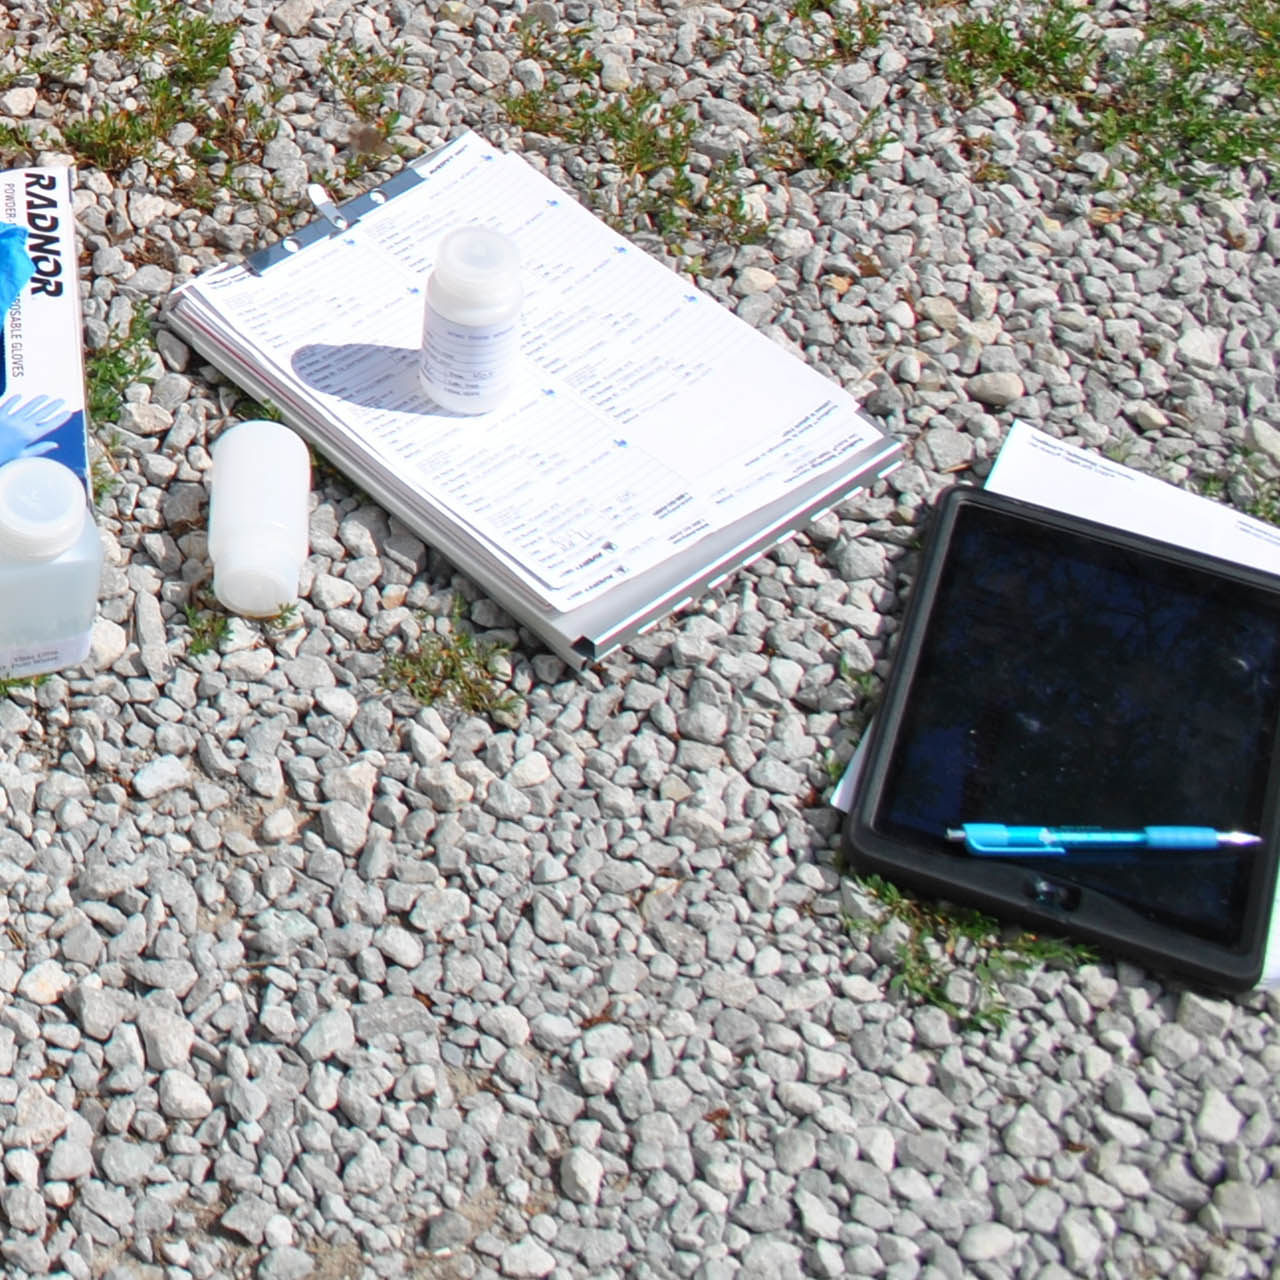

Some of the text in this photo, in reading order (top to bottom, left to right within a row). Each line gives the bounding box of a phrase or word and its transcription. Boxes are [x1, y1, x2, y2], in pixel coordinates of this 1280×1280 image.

[3, 183, 24, 378] POWDER- POSABLE GLOVES
[24, 173, 64, 297] RADNOR
